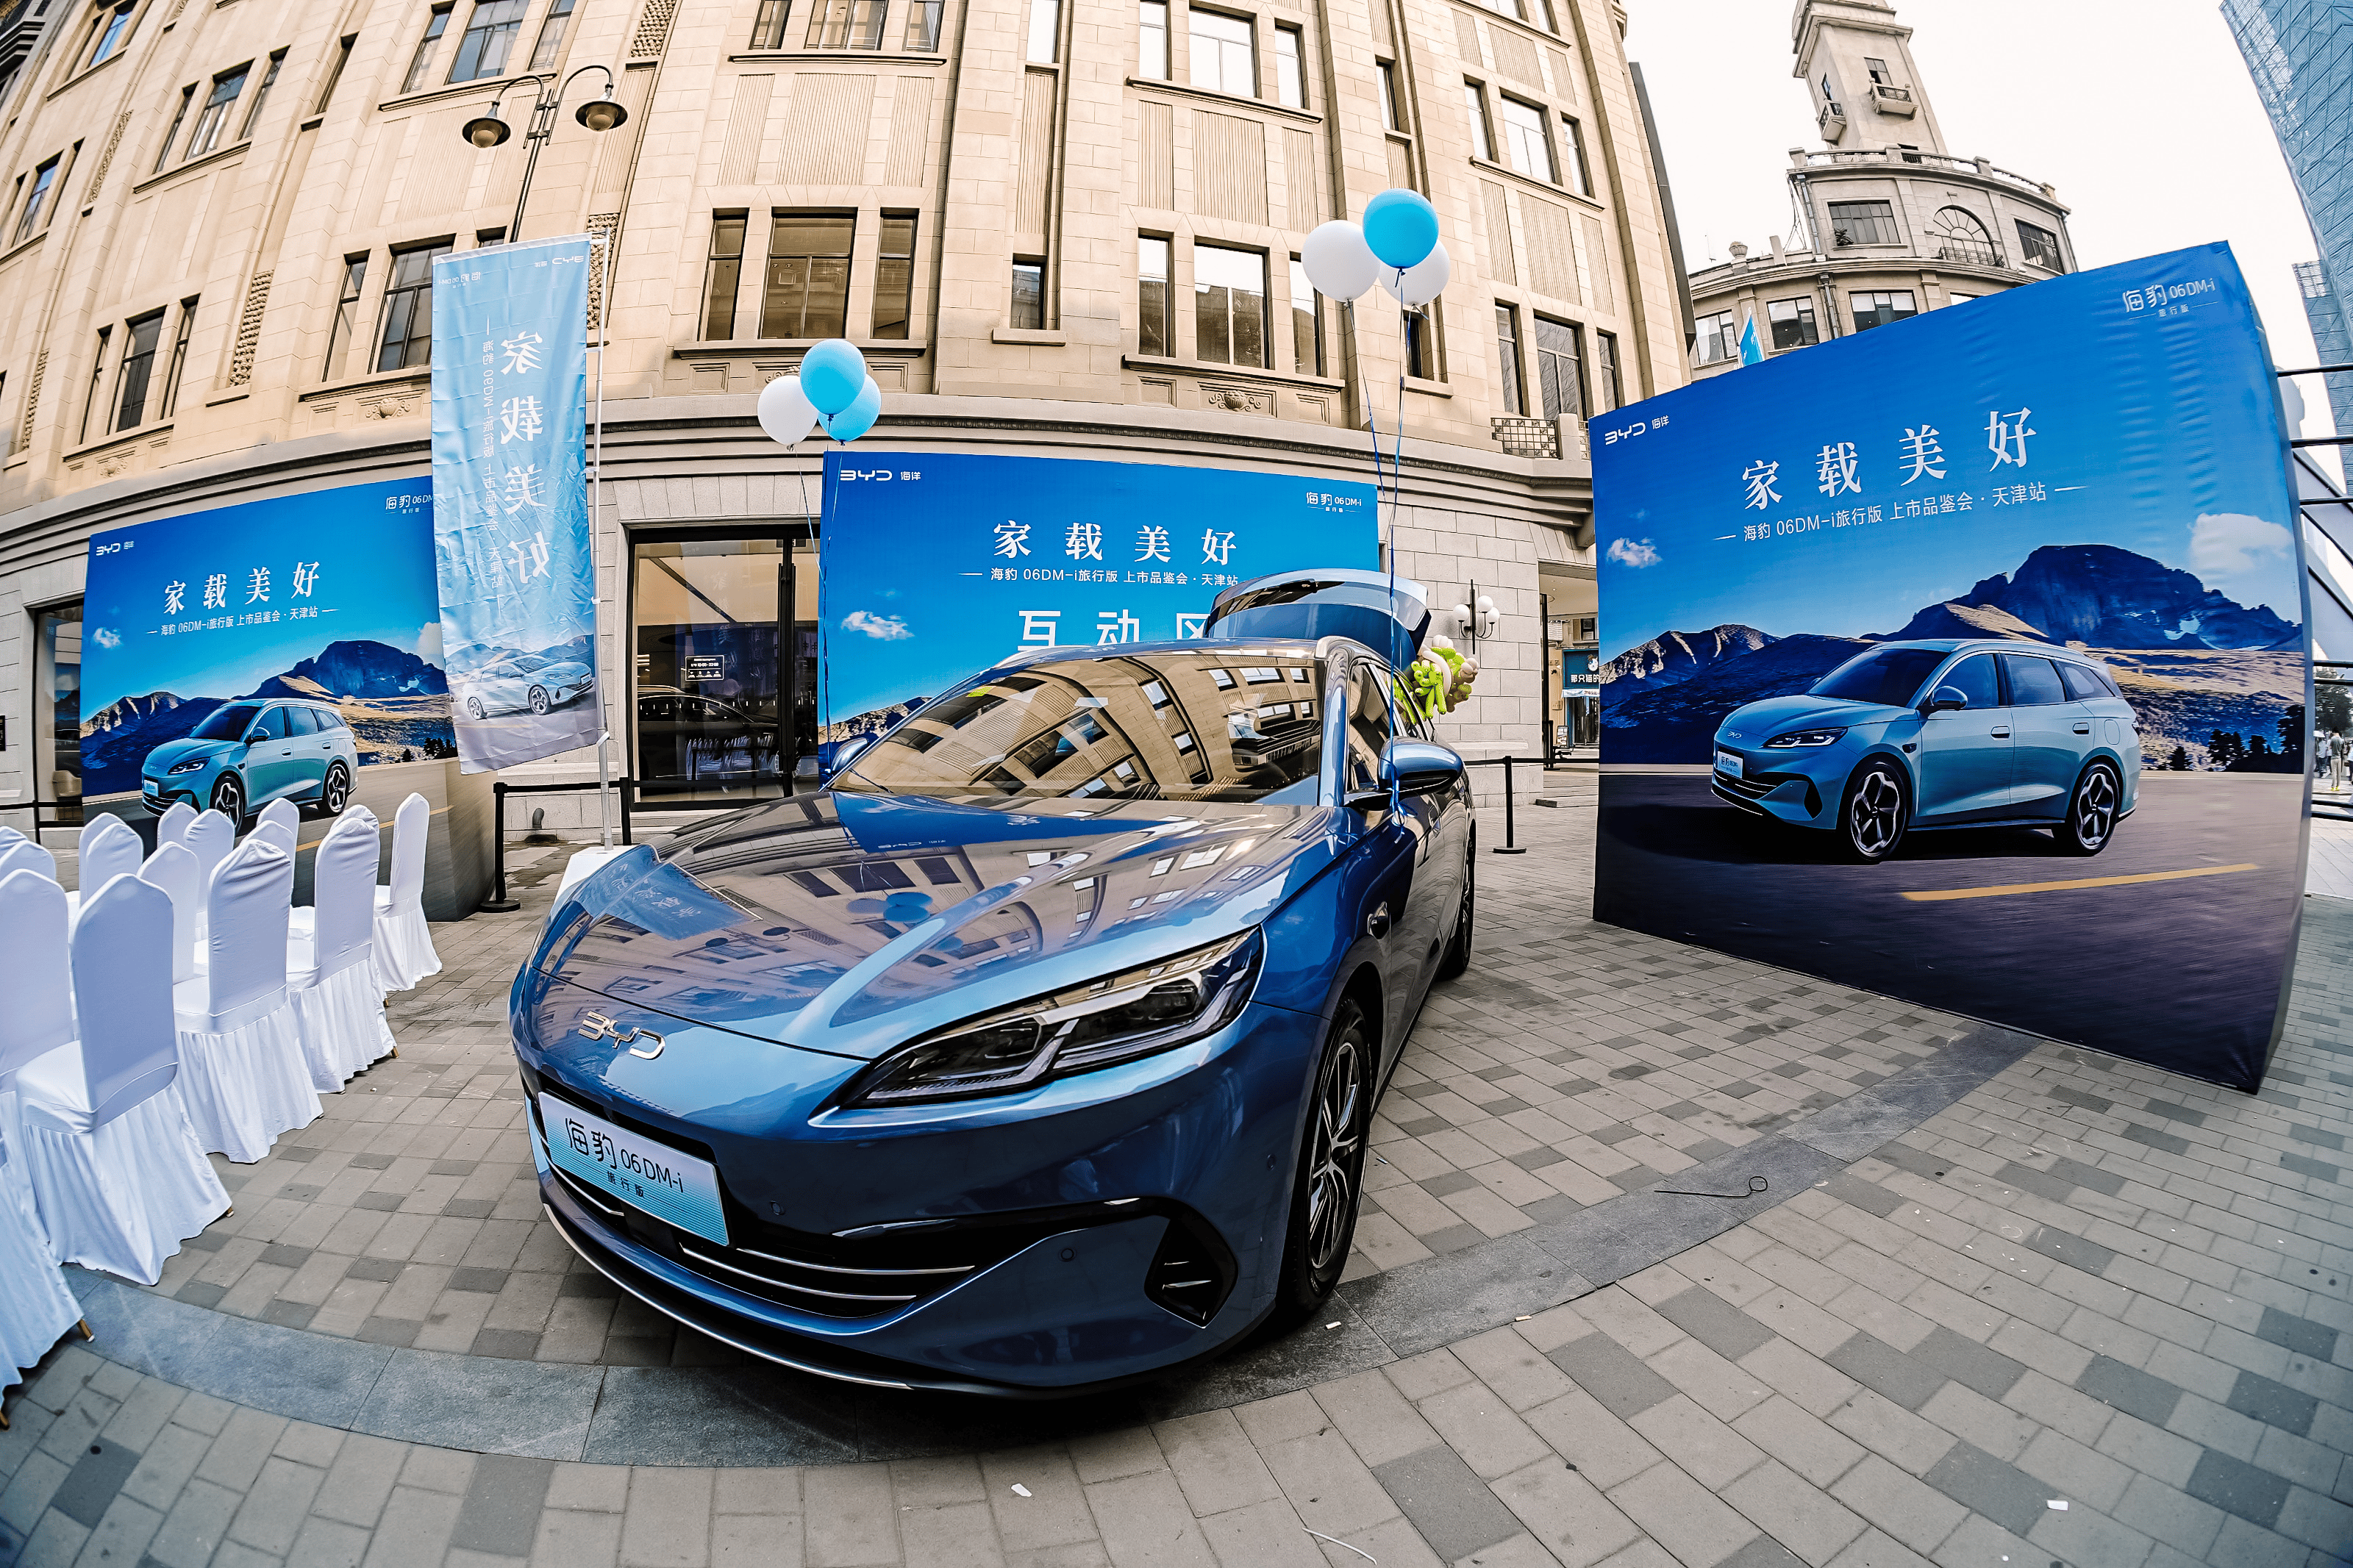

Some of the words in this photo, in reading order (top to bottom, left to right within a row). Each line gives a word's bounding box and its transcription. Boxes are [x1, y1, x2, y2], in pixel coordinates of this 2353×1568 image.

[2122, 284, 2168, 312] 海豹
[2168, 277, 2215, 298] 06DM-i
[1604, 422, 1646, 445] BYD
[1652, 415, 1670, 430] 海洋
[1742, 407, 2037, 510] 家载美好
[840, 470, 893, 482] BYD
[900, 471, 921, 481] 海洋
[385, 494, 411, 510] 海豹
[412, 494, 433, 504] 06DM
[1306, 491, 1332, 506] 海豹
[993, 520, 1237, 565] 家载美好
[1743, 523, 1771, 543] 海豹
[96, 543, 121, 556] BYD
[163, 561, 320, 615] 家载美好
[990, 567, 1018, 581] 海豹
[161, 623, 176, 636] 海豹
[1017, 609, 1211, 651] 互动区
[578, 1010, 666, 1061] BYD
[565, 1117, 618, 1170] 海豹
[621, 1148, 684, 1193] 06DM-i
[607, 1171, 645, 1199] 旅行版
